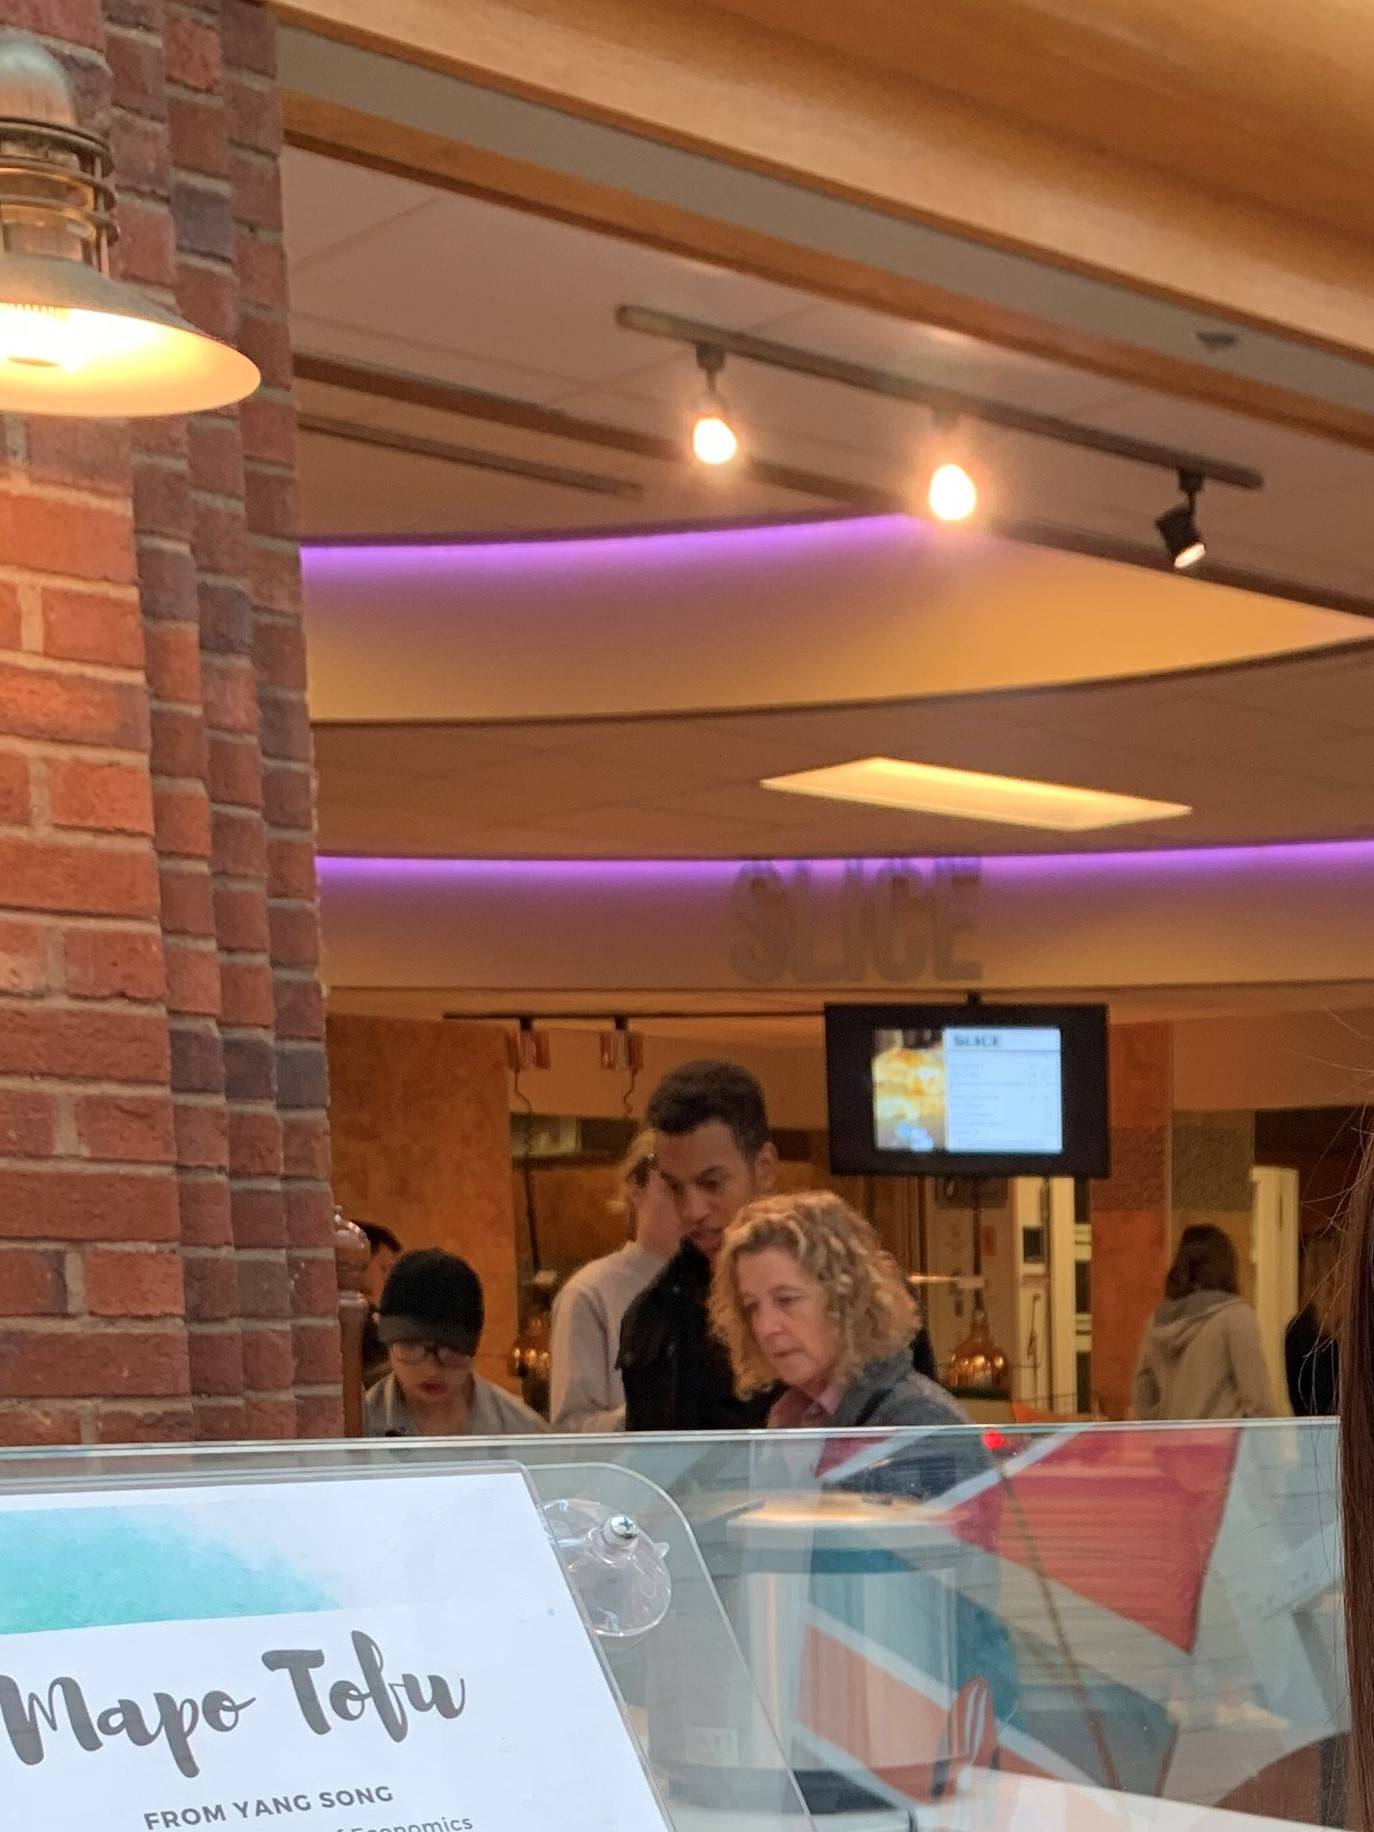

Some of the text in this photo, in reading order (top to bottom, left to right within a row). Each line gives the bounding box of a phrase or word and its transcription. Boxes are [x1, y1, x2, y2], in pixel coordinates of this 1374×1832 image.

[730, 857, 984, 982] SLICE
[0, 1630, 466, 1778] Mapo Tofu
[143, 1785, 394, 1830] FROM YANG SONG
